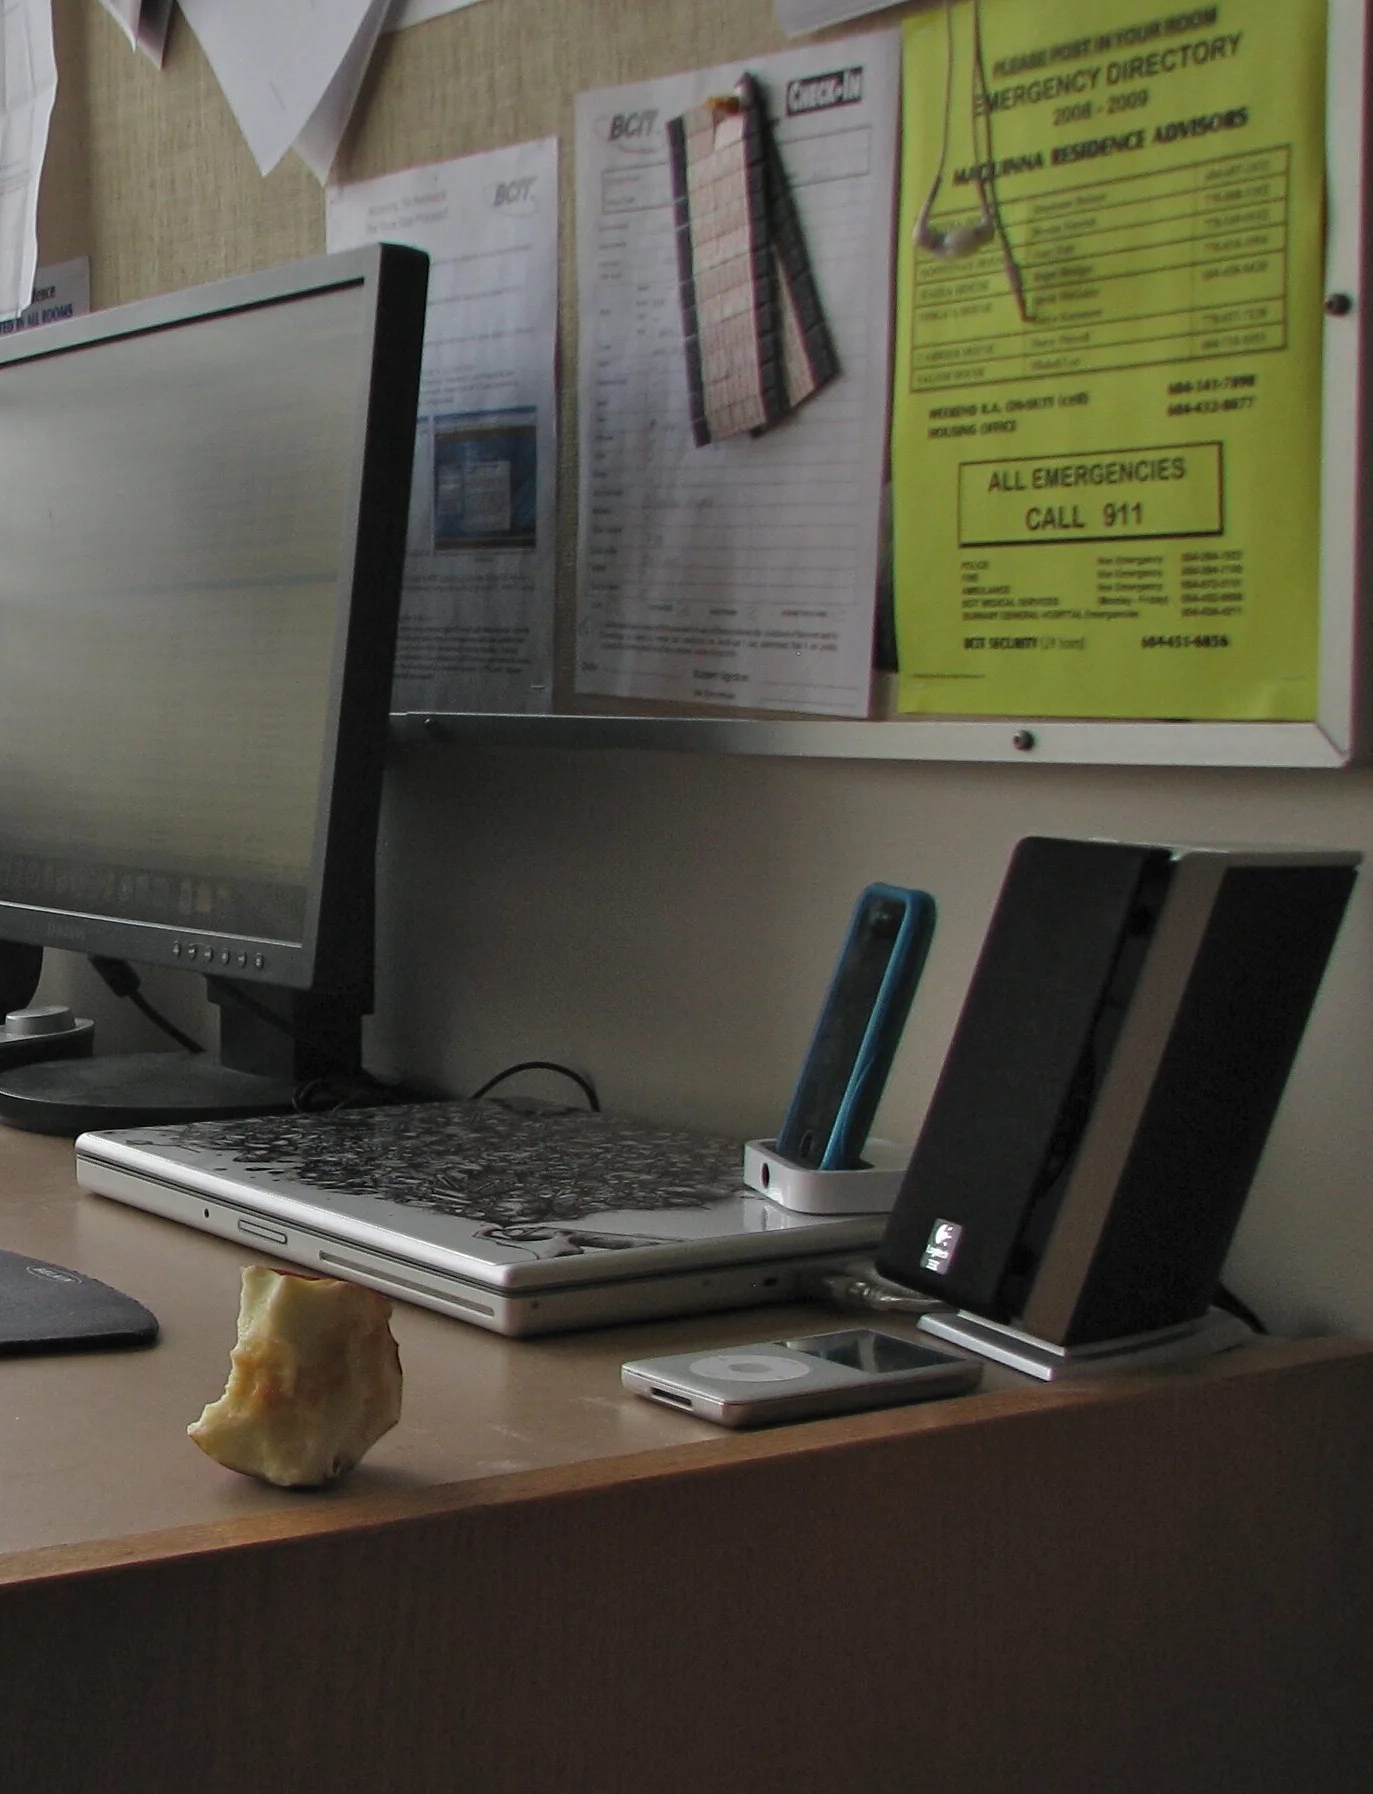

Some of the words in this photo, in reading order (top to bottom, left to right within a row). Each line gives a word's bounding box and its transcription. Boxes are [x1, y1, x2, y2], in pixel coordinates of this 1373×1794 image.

[1049, 38, 1092, 60] POST
[1094, 35, 1112, 52] IN
[1114, 22, 1161, 46] YOUR
[1163, 5, 1219, 32] ROOM
[974, 67, 1101, 117] EMERGENCY
[1106, 31, 1243, 86] DIRECTORY
[608, 109, 659, 141] BCIT
[1053, 101, 1092, 126] 2008
[1106, 89, 1149, 114] 2009
[1050, 129, 1146, 165] RESIDENCE
[1153, 106, 1249, 144] ADVISORS
[42, 304, 73, 323] ROOMS
[988, 469, 1026, 493] ALL
[1032, 457, 1186, 490] EMERGENCIES
[1025, 505, 1085, 531] CALL
[1103, 502, 1143, 528] 911
